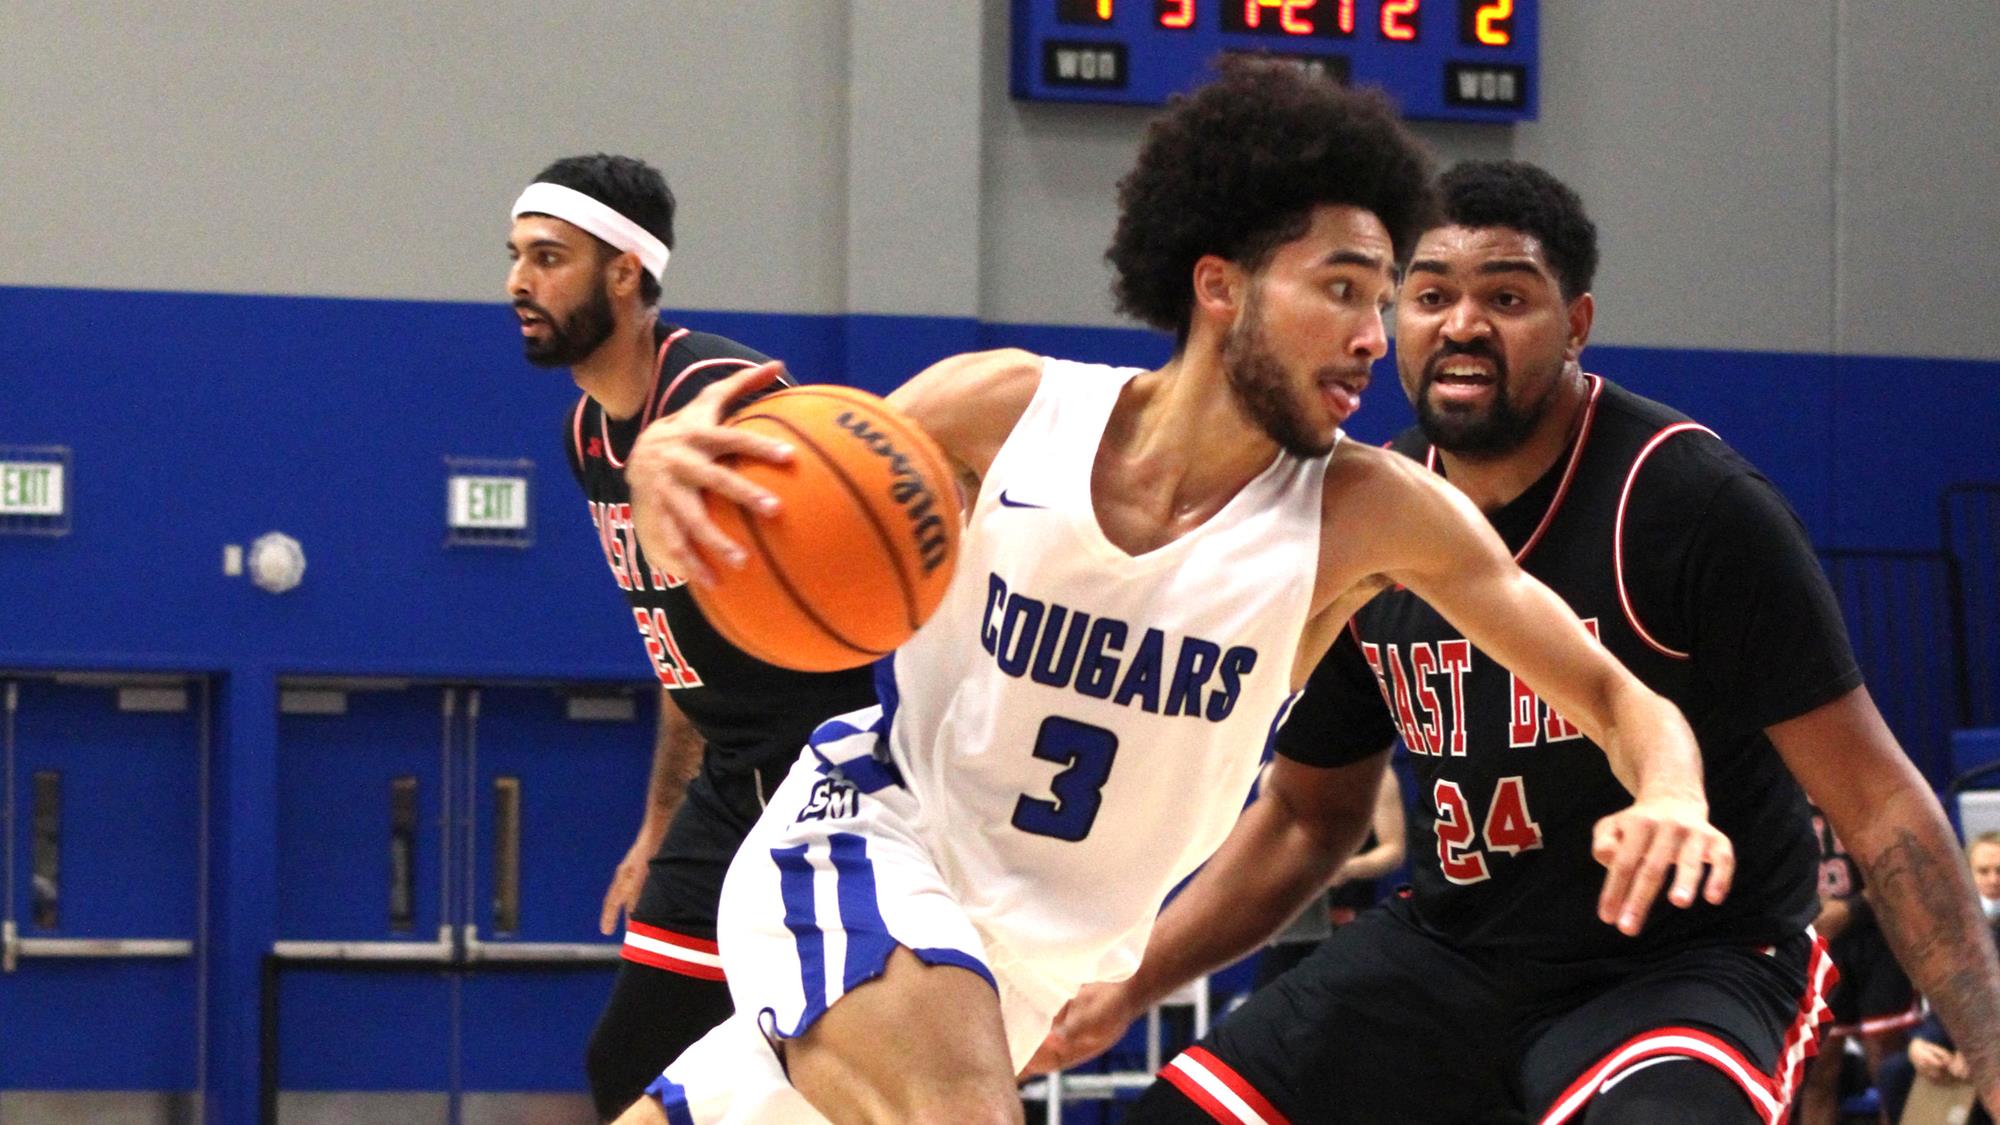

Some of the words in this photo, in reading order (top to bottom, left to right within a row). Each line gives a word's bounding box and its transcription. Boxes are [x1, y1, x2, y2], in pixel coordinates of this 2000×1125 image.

[3, 467, 50, 507] EXIT
[467, 482, 514, 520] EXIT
[632, 606, 704, 689] 21
[980, 571, 1258, 723] COUGARS
[1010, 715, 1120, 842] 3
[1434, 775, 1544, 885] 24
